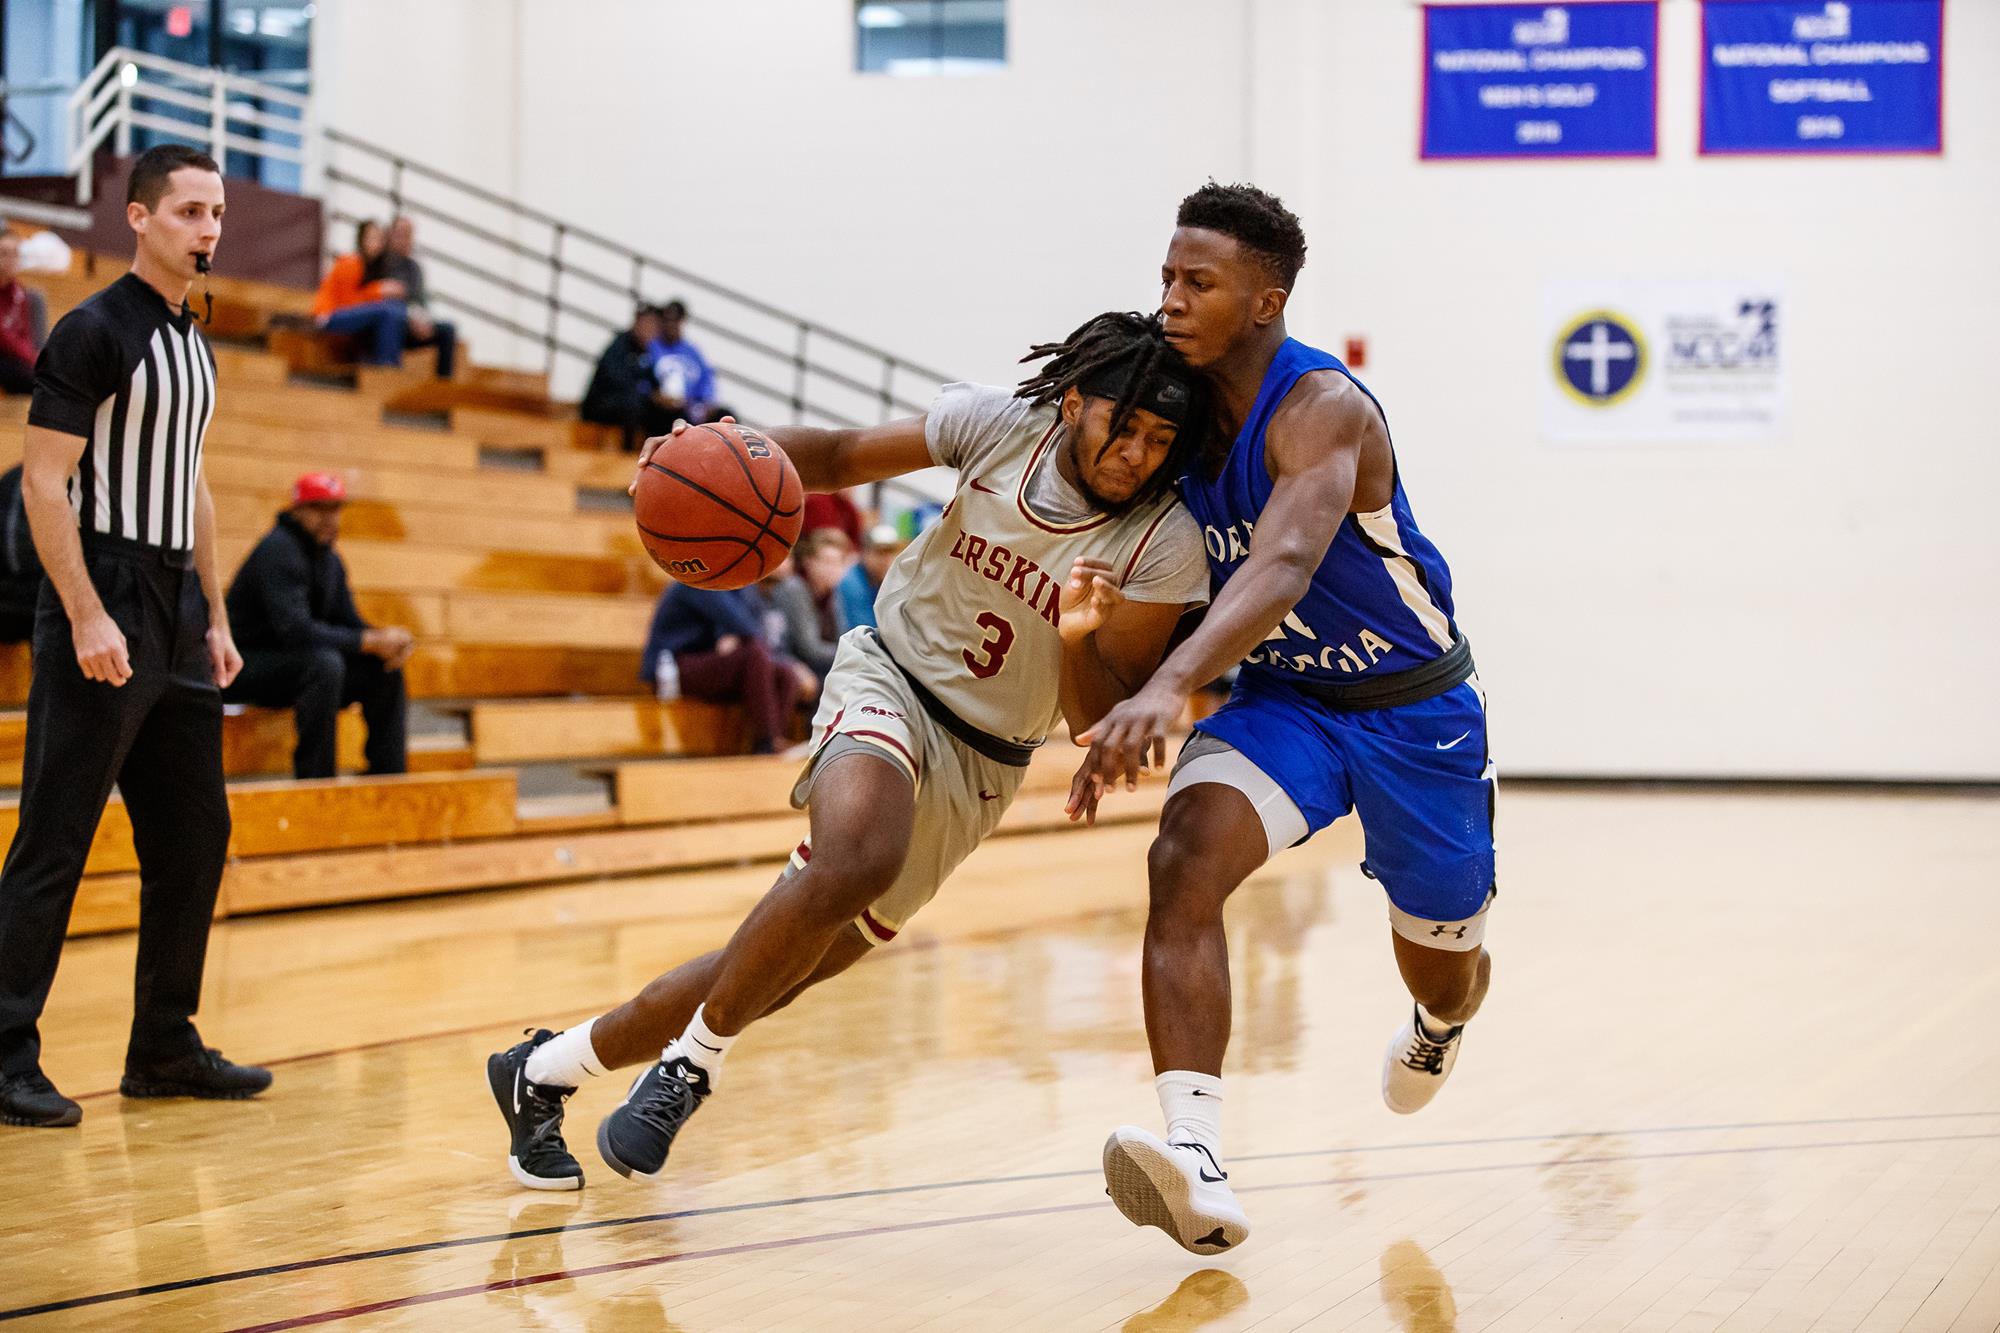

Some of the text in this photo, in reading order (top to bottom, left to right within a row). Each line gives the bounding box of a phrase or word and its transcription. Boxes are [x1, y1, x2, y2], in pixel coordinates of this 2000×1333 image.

[1435, 46, 1645, 71] NATIONAL CHAMPIONS
[1713, 41, 1929, 66] NATIONAL CHAMPIONS
[1768, 79, 1871, 102] SOFTBALL
[962, 611, 1016, 679] 3
